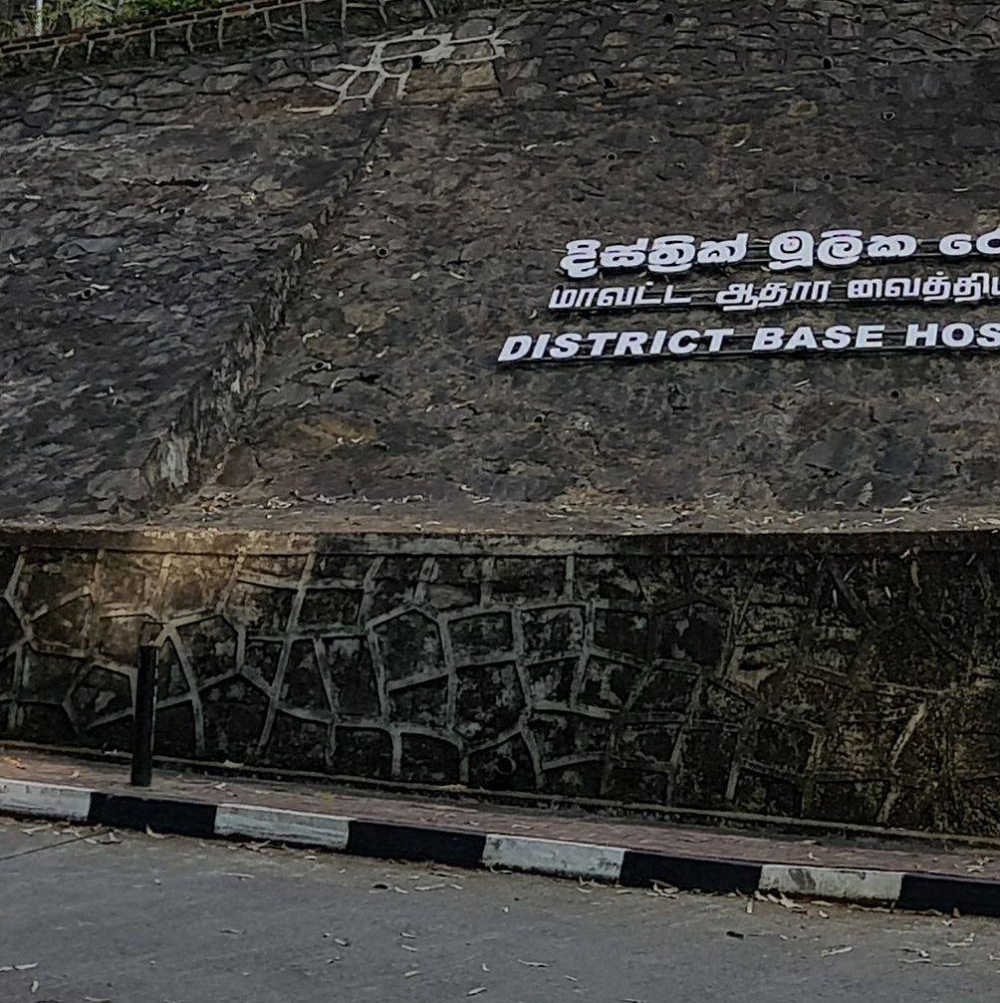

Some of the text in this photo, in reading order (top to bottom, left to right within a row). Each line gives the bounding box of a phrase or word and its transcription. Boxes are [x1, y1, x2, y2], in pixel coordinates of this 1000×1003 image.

[548, 281, 692, 309] மாவட்ட
[715, 280, 832, 311] ஆதார
[497, 328, 735, 362] DISTRICT
[751, 324, 886, 351] BASE
